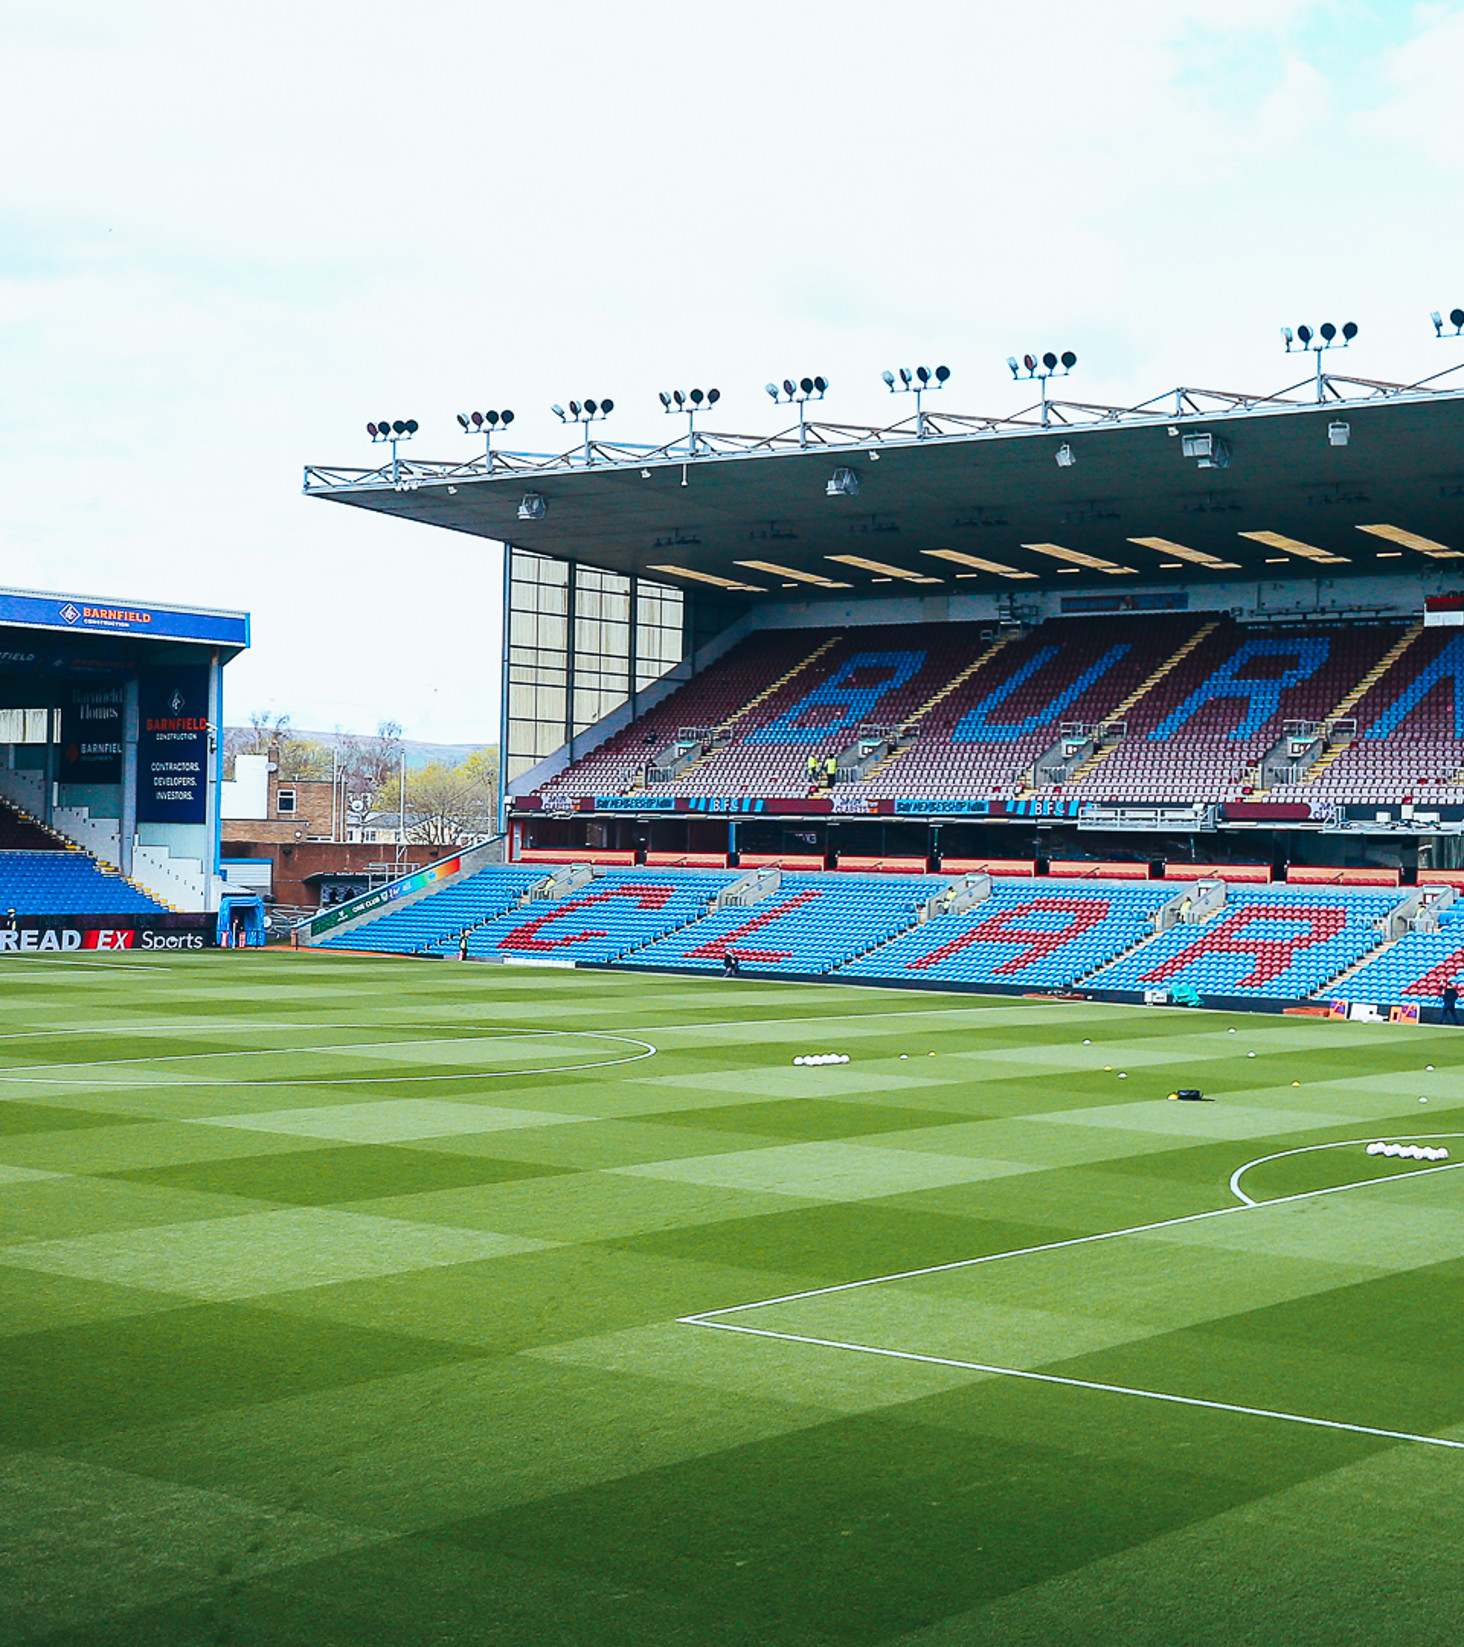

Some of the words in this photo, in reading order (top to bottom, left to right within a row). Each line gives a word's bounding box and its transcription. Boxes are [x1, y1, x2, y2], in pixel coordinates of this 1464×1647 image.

[83, 607, 152, 623] BARNFIELD
[80, 704, 118, 720] Homes
[146, 717, 207, 731] BARNFIELD
[155, 732, 198, 741] CONSTRUCTION
[81, 743, 122, 754] BARNFIEL
[151, 762, 200, 772] CONTRACTORS.
[153, 777, 198, 787] DEVELOPERS.
[156, 791, 195, 800] INVESTORS.
[141, 931, 203, 949] Sports
